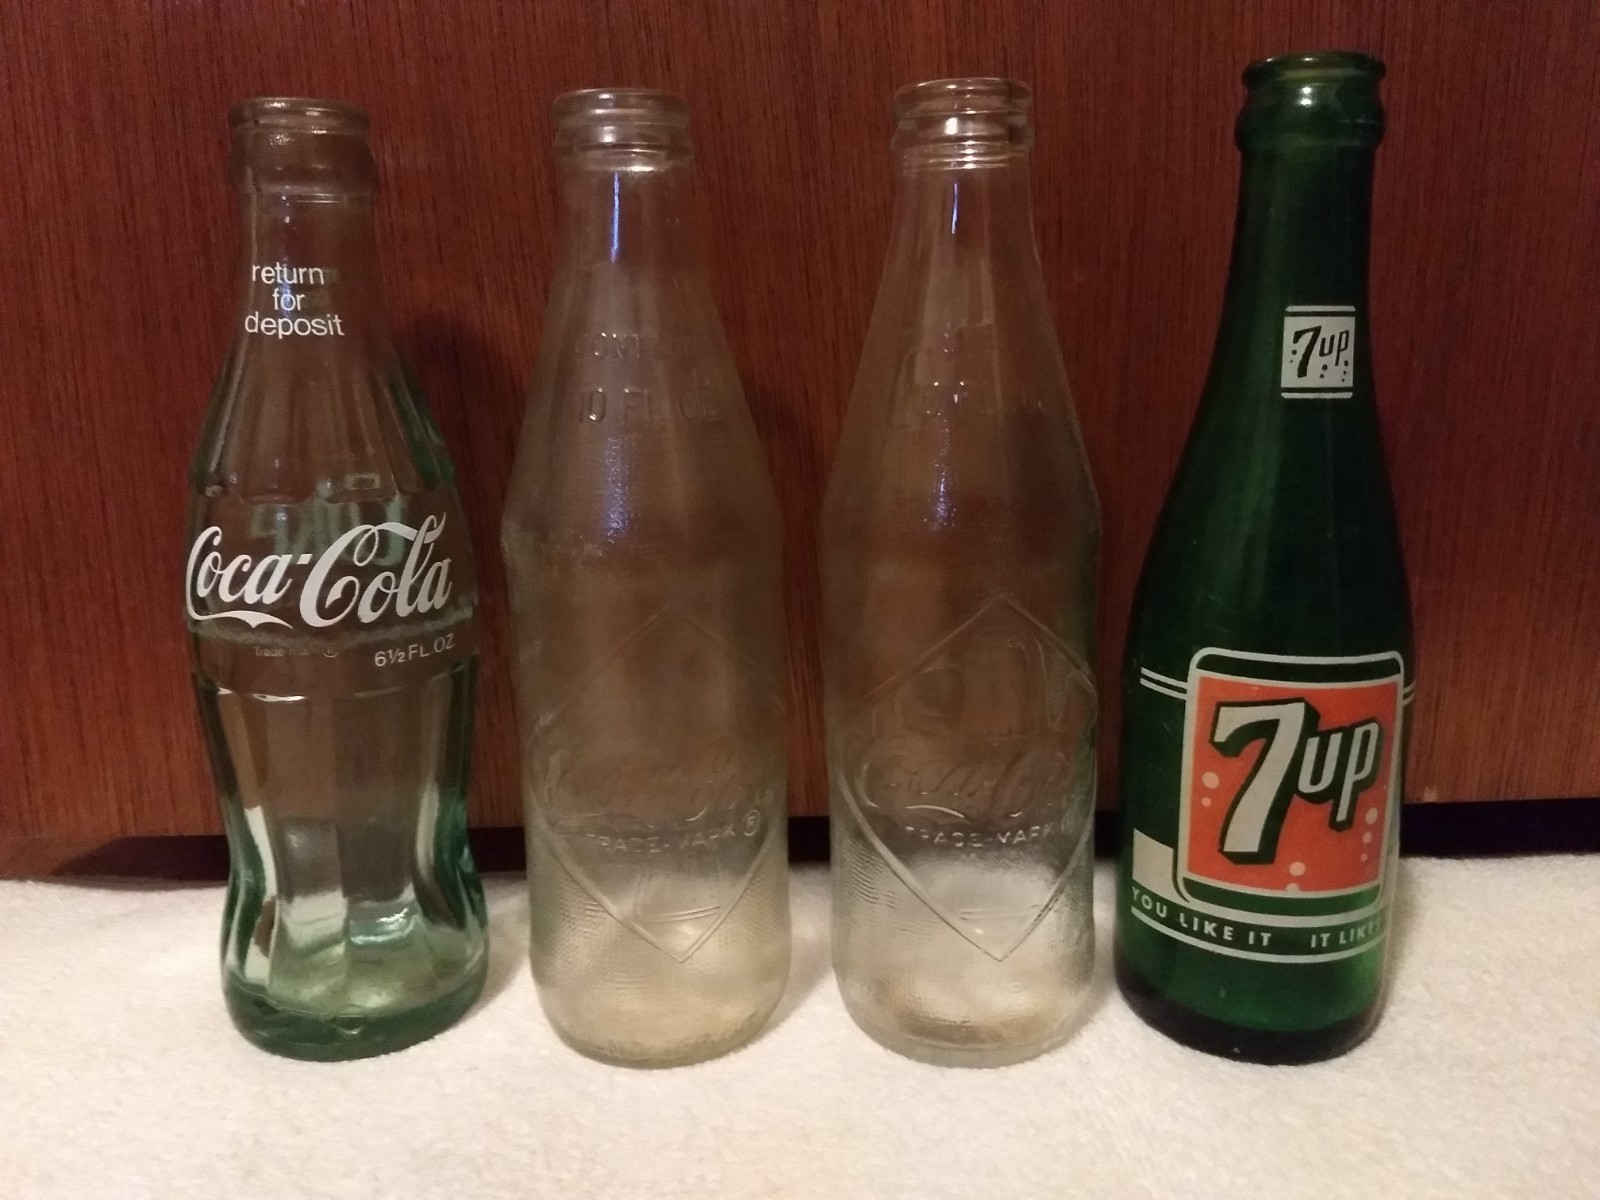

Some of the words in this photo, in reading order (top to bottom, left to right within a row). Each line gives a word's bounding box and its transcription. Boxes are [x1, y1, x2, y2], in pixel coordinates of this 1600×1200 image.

[252, 262, 325, 285] return
[272, 288, 306, 311] for
[244, 311, 346, 340] deposit
[185, 512, 453, 629] Coca-Cola
[1131, 886, 1168, 918] YOU
[1179, 912, 1235, 941] LIKE
[1248, 930, 1272, 947] IT
[1310, 932, 1331, 948] IT
